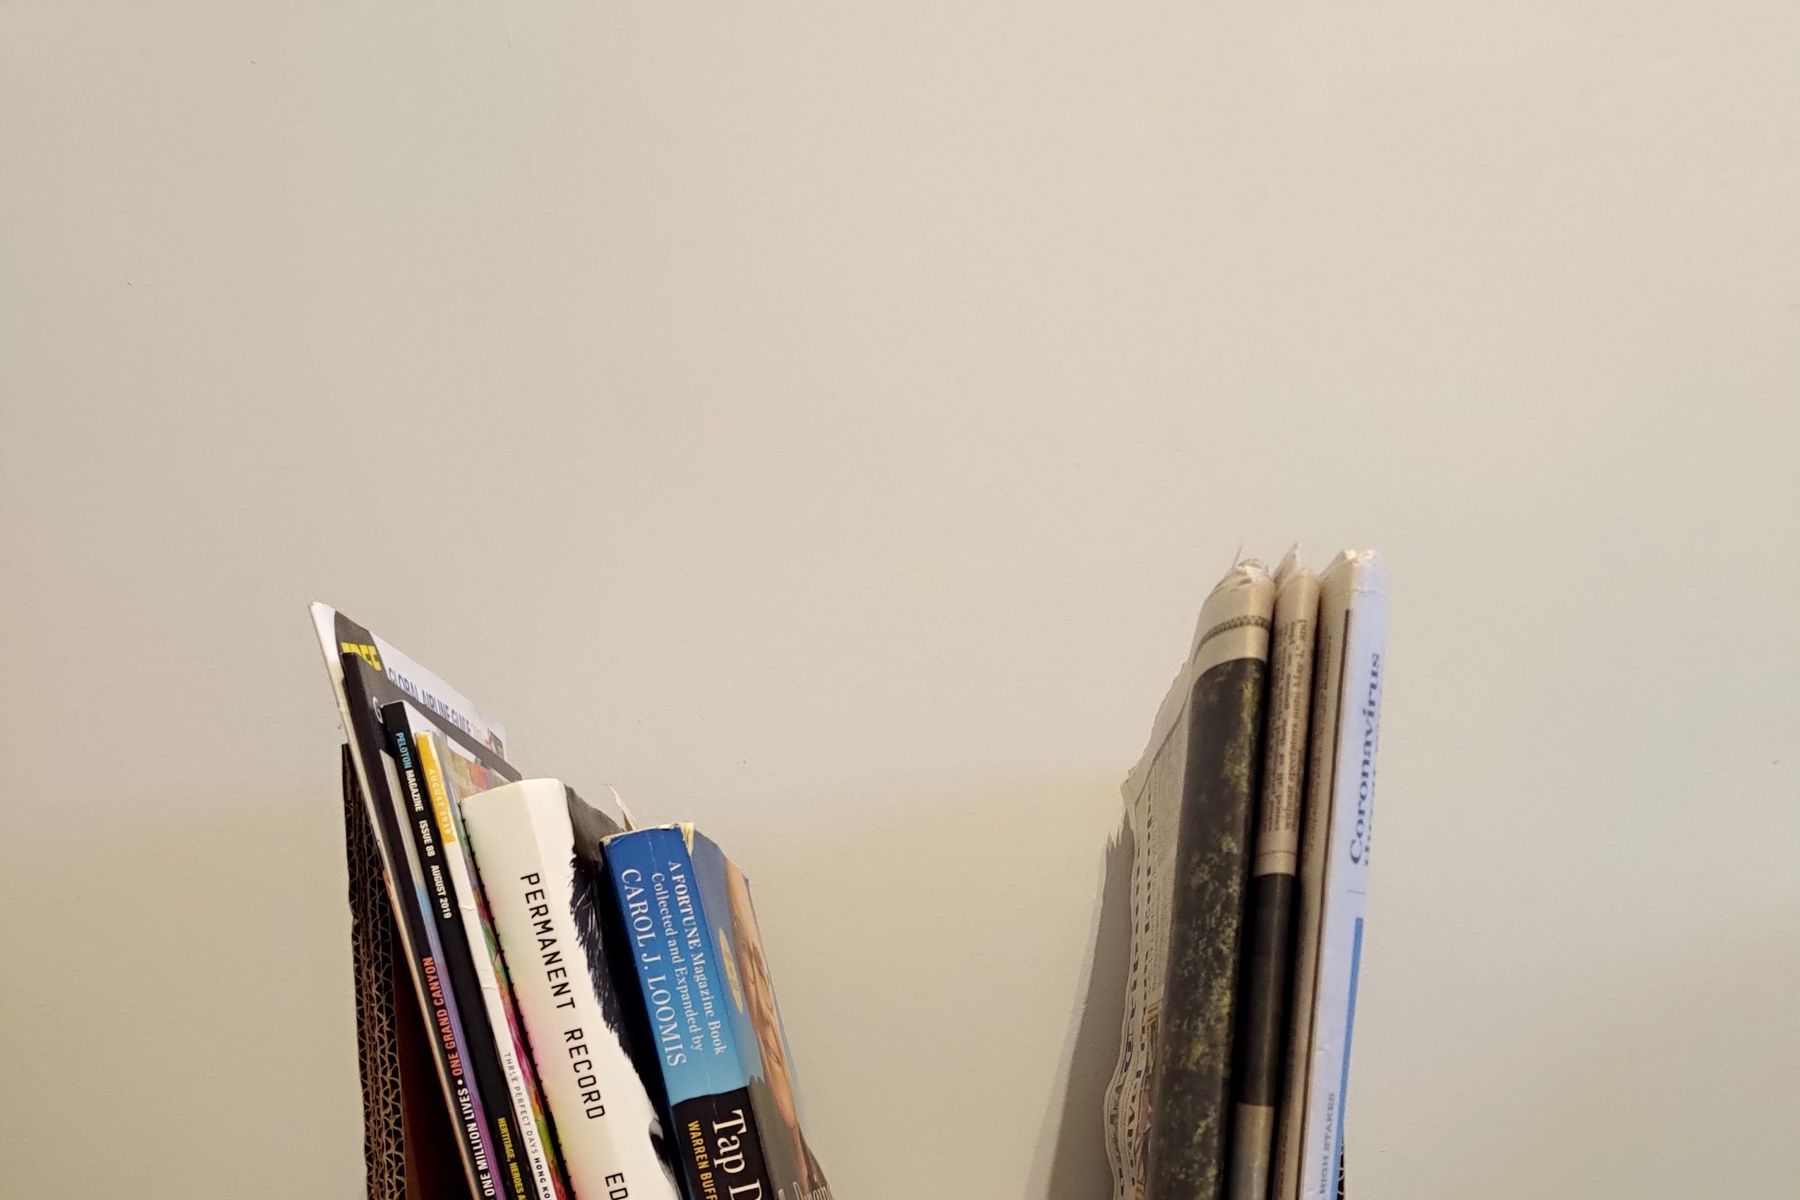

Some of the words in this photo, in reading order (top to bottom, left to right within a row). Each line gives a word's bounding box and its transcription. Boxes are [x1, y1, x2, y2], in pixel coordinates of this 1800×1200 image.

[393, 731, 411, 769] PELOTON
[1349, 653, 1380, 864] Coronavirus
[404, 769, 423, 812] MAGAZINE
[417, 819, 432, 844] ISSUE
[424, 843, 435, 858] 88
[429, 863, 446, 896] AUGUST
[668, 859, 681, 872] A
[620, 866, 657, 948] CAROL
[651, 872, 677, 936] Collected
[671, 874, 701, 950] FORTUNE
[641, 949, 662, 970] J.
[667, 937, 684, 963] and
[422, 955, 444, 1006] CANYON
[519, 871, 575, 1013] PERMANENT
[564, 1027, 605, 1120] RECORD
[672, 965, 701, 1033] Expanded
[689, 950, 717, 1017] Magazine
[436, 1007, 456, 1049] GRAND
[647, 973, 686, 1067] LOOMIS
[707, 1018, 727, 1055] Book
[448, 1051, 463, 1076] ONE
[689, 1034, 706, 1052] by
[458, 1086, 475, 1120] LIVES
[467, 1122, 488, 1170] MILLION
[512, 1085, 530, 1127] PERFECT
[525, 1129, 538, 1155] DAYS
[533, 1156, 547, 1183] HONG
[686, 1120, 709, 1168] WARREN
[711, 1108, 748, 1175] Tap
[480, 1170, 495, 1196] ONE
[508, 1161, 524, 1194] HEROES
